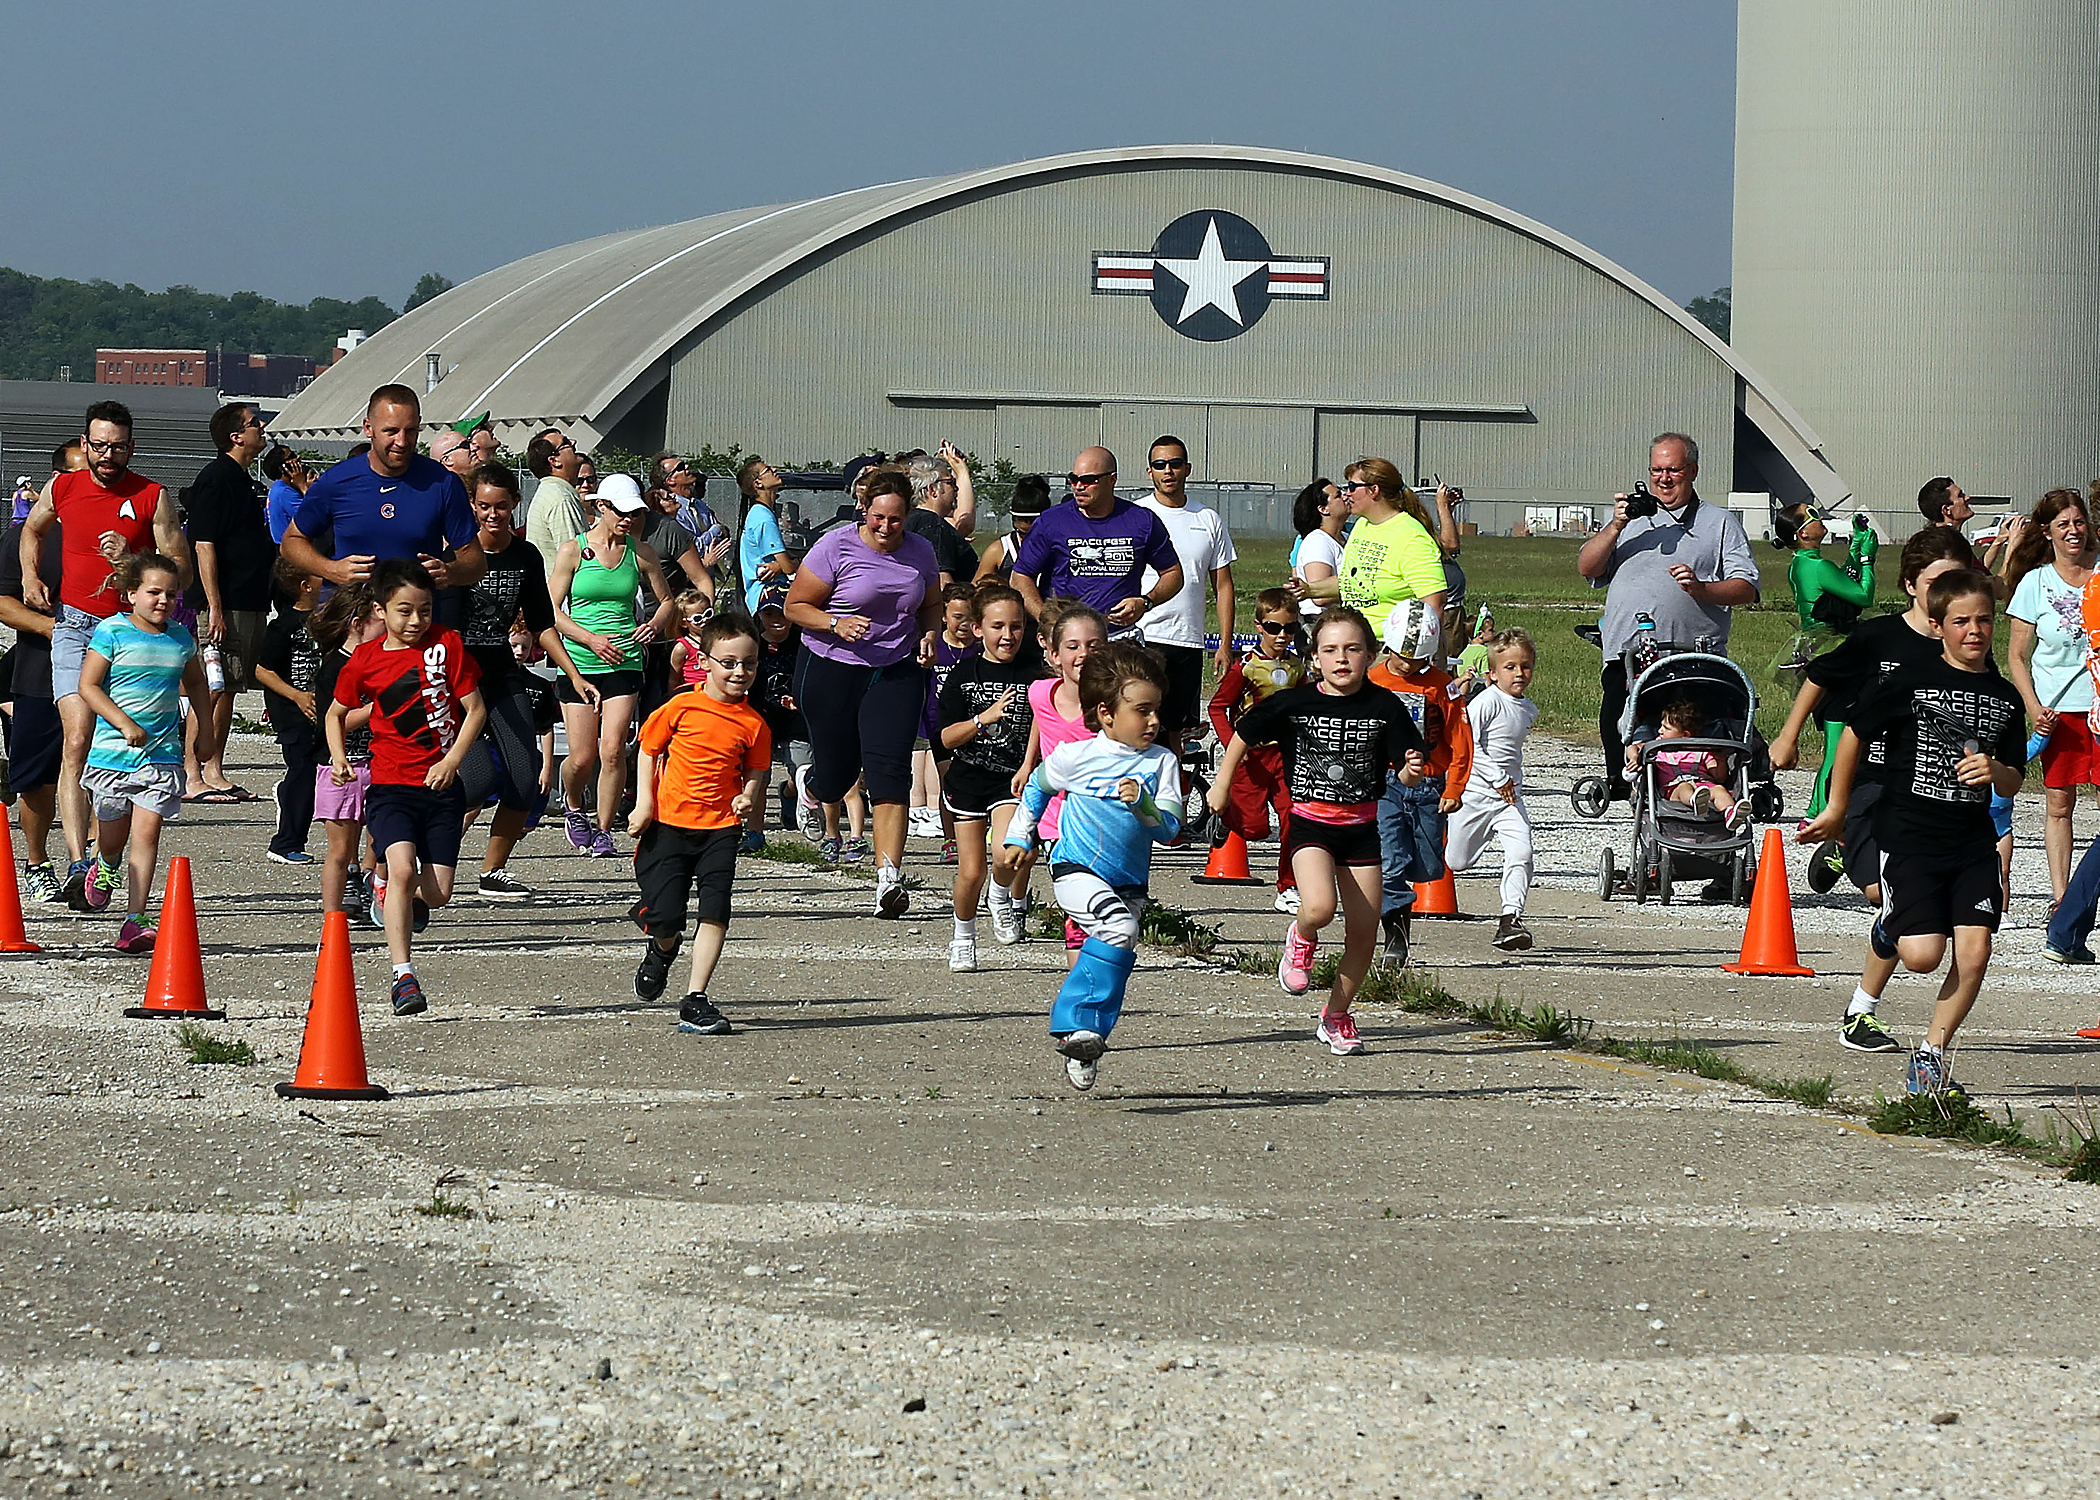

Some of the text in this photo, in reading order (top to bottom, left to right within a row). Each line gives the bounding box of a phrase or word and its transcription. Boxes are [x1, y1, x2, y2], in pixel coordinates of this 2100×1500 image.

[1067, 537, 1133, 546] SPACE FEST
[1104, 551, 1134, 561] 2014
[1914, 689, 1975, 702] SPACE
[1344, 718, 1386, 729] FEST
[1290, 785, 1336, 801] SPACE
